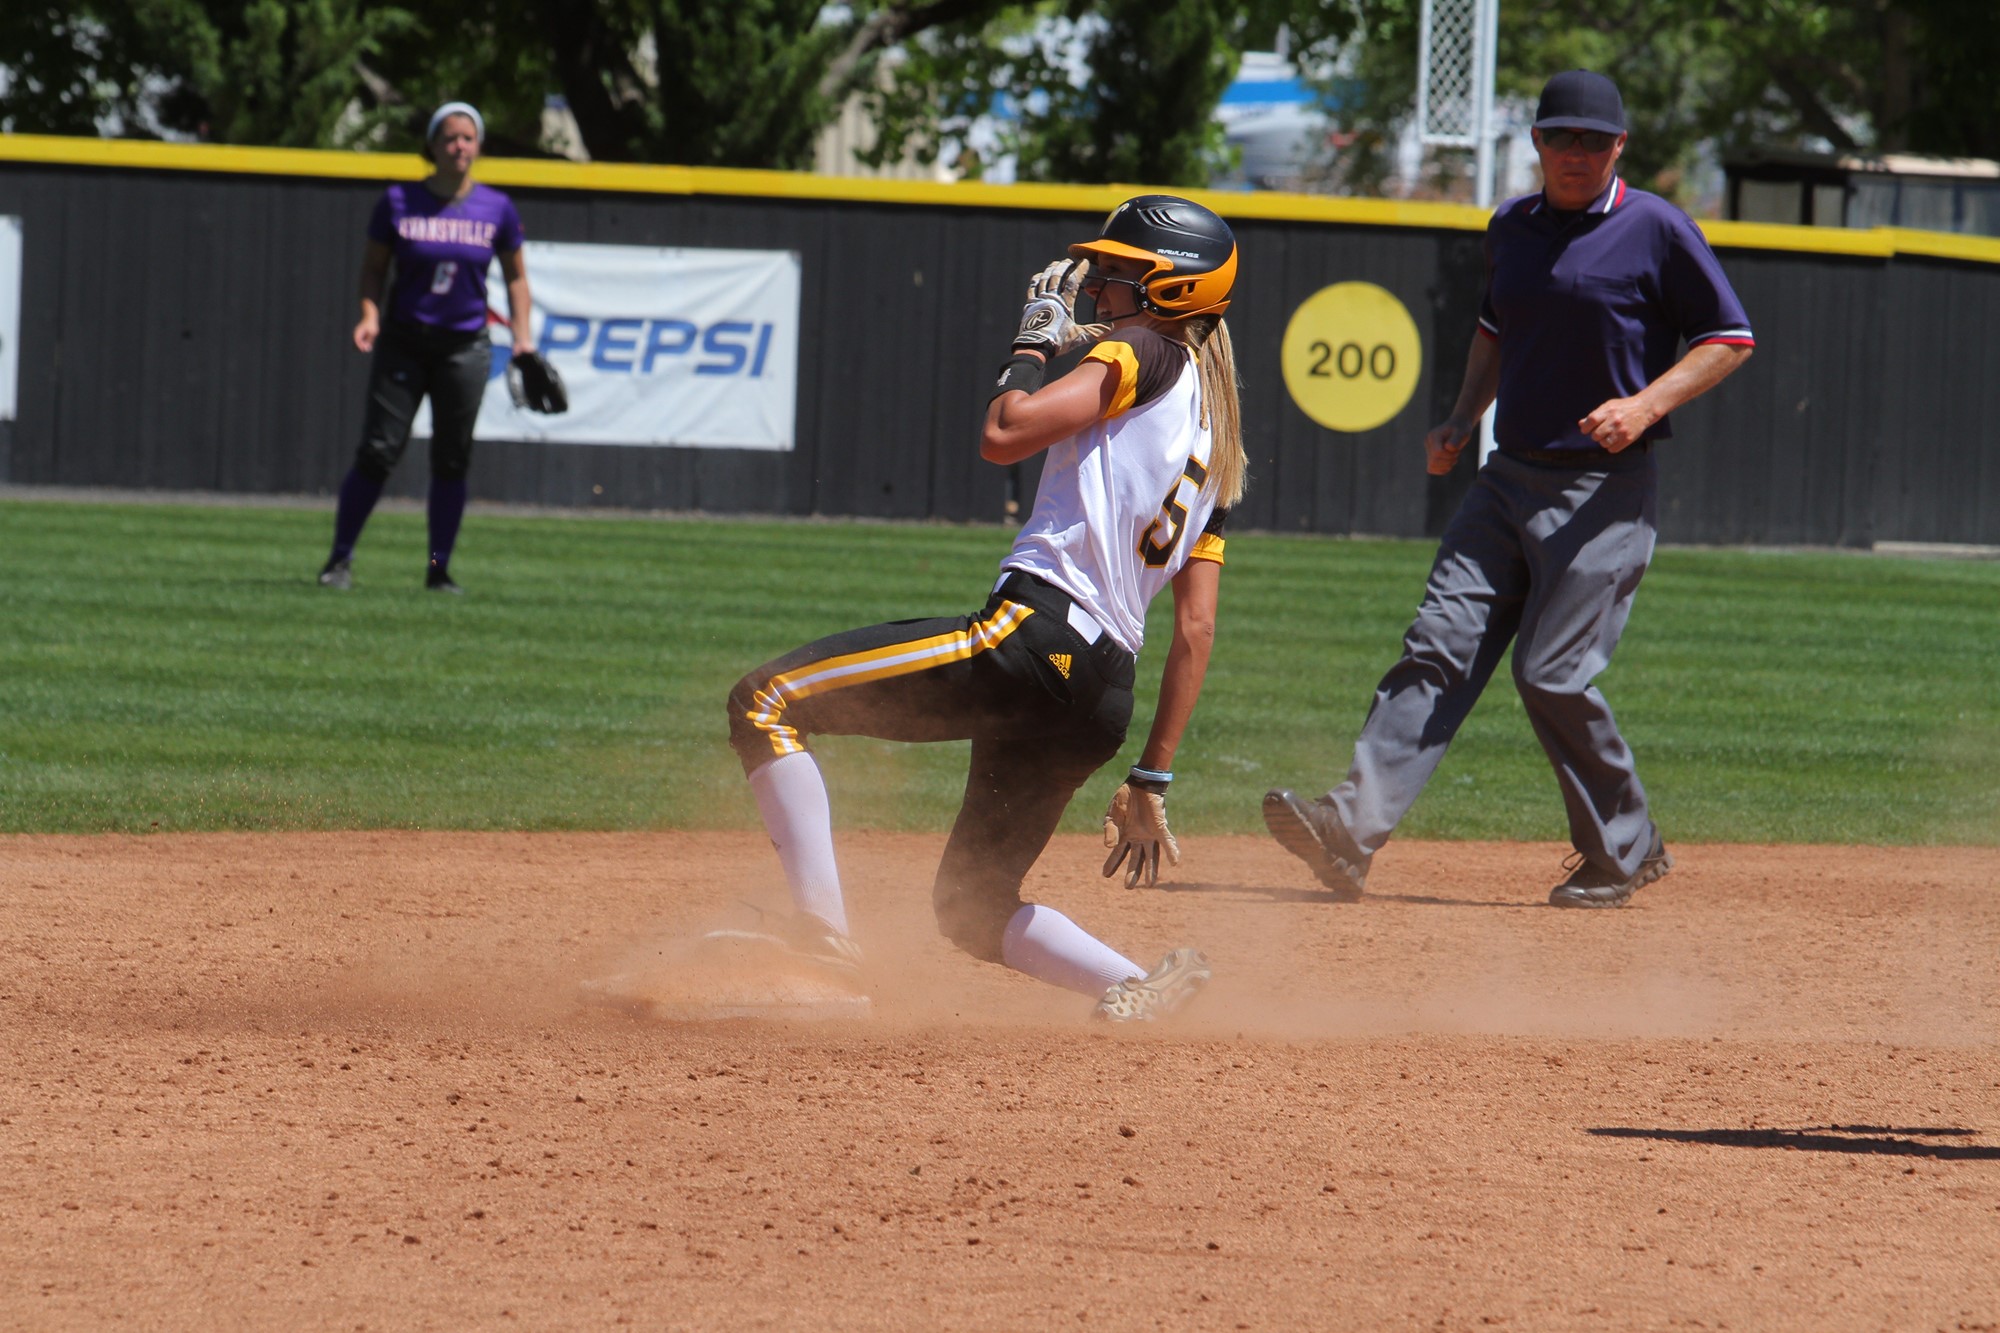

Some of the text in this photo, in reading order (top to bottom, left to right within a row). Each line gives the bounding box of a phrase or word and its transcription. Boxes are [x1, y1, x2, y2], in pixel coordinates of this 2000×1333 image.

[1157, 248, 1200, 259] RAWLINGS
[538, 314, 774, 378] PEPSI
[1308, 341, 1396, 380] 200
[1136, 454, 1210, 569] 5
[1048, 653, 1071, 680] adidas
